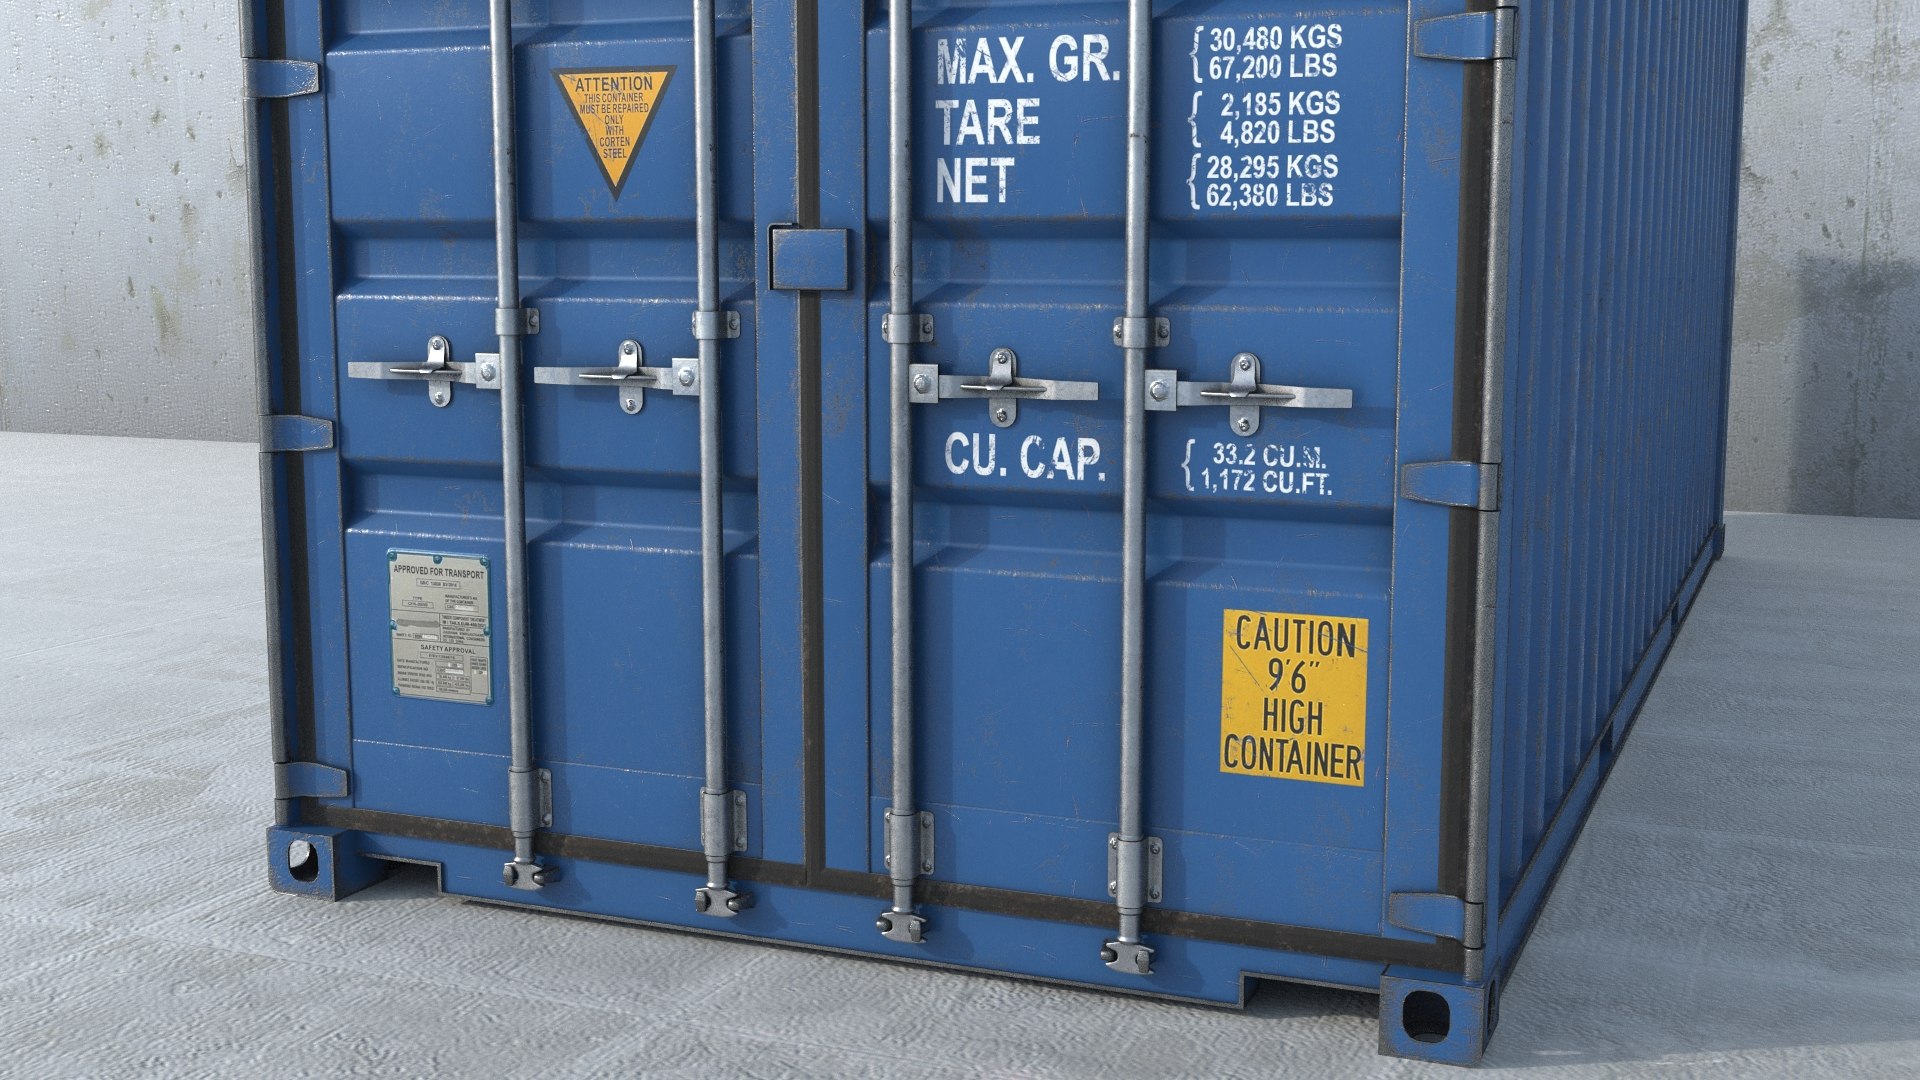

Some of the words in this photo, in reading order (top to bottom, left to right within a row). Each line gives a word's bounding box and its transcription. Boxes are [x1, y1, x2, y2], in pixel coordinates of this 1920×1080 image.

[1209, 27, 1283, 53] 30,480
[1290, 24, 1343, 49] KGS
[937, 36, 1034, 85] MAX.
[1049, 34, 1121, 82] GR.
[1208, 55, 1282, 83] 67,200
[1289, 53, 1338, 77] LBS
[575, 76, 653, 92] ATTENTION
[584, 93, 601, 103] THIS
[602, 92, 644, 103] CONTAINER
[580, 105, 600, 114] MUST
[601, 105, 612, 114] BE
[612, 103, 649, 114] REPAIRED
[1220, 93, 1281, 119] 2,185
[1287, 91, 1341, 116] KGS
[604, 115, 624, 125] ONLY
[605, 125, 624, 136] WITH
[935, 98, 1041, 146] TARE
[1220, 121, 1280, 147] 4,820
[1287, 120, 1336, 144] LBS
[599, 137, 630, 148] CORTEN
[603, 148, 627, 159] STEEL
[936, 157, 1015, 203] NET
[1206, 156, 1280, 182] 28,295
[1286, 154, 1339, 180] KGS
[1206, 183, 1279, 210] 62,380
[1285, 183, 1334, 207] LBS
[945, 431, 1007, 477] CU.
[1020, 434, 1106, 482] CAP.
[1213, 442, 1256, 466] 33.2
[1263, 444, 1327, 470] CU.M.
[1201, 468, 1255, 495] 1,172
[1262, 470, 1333, 496] CU.FT.
[393, 565, 428, 575] APPROVED
[430, 567, 443, 576] FOR
[444, 568, 485, 579] TRANSPORT
[1236, 614, 1356, 658] CAUTION
[444, 646, 476, 655] APPROVAL
[1263, 697, 1323, 736] HIGH
[1224, 733, 1361, 781] CONTAINER
